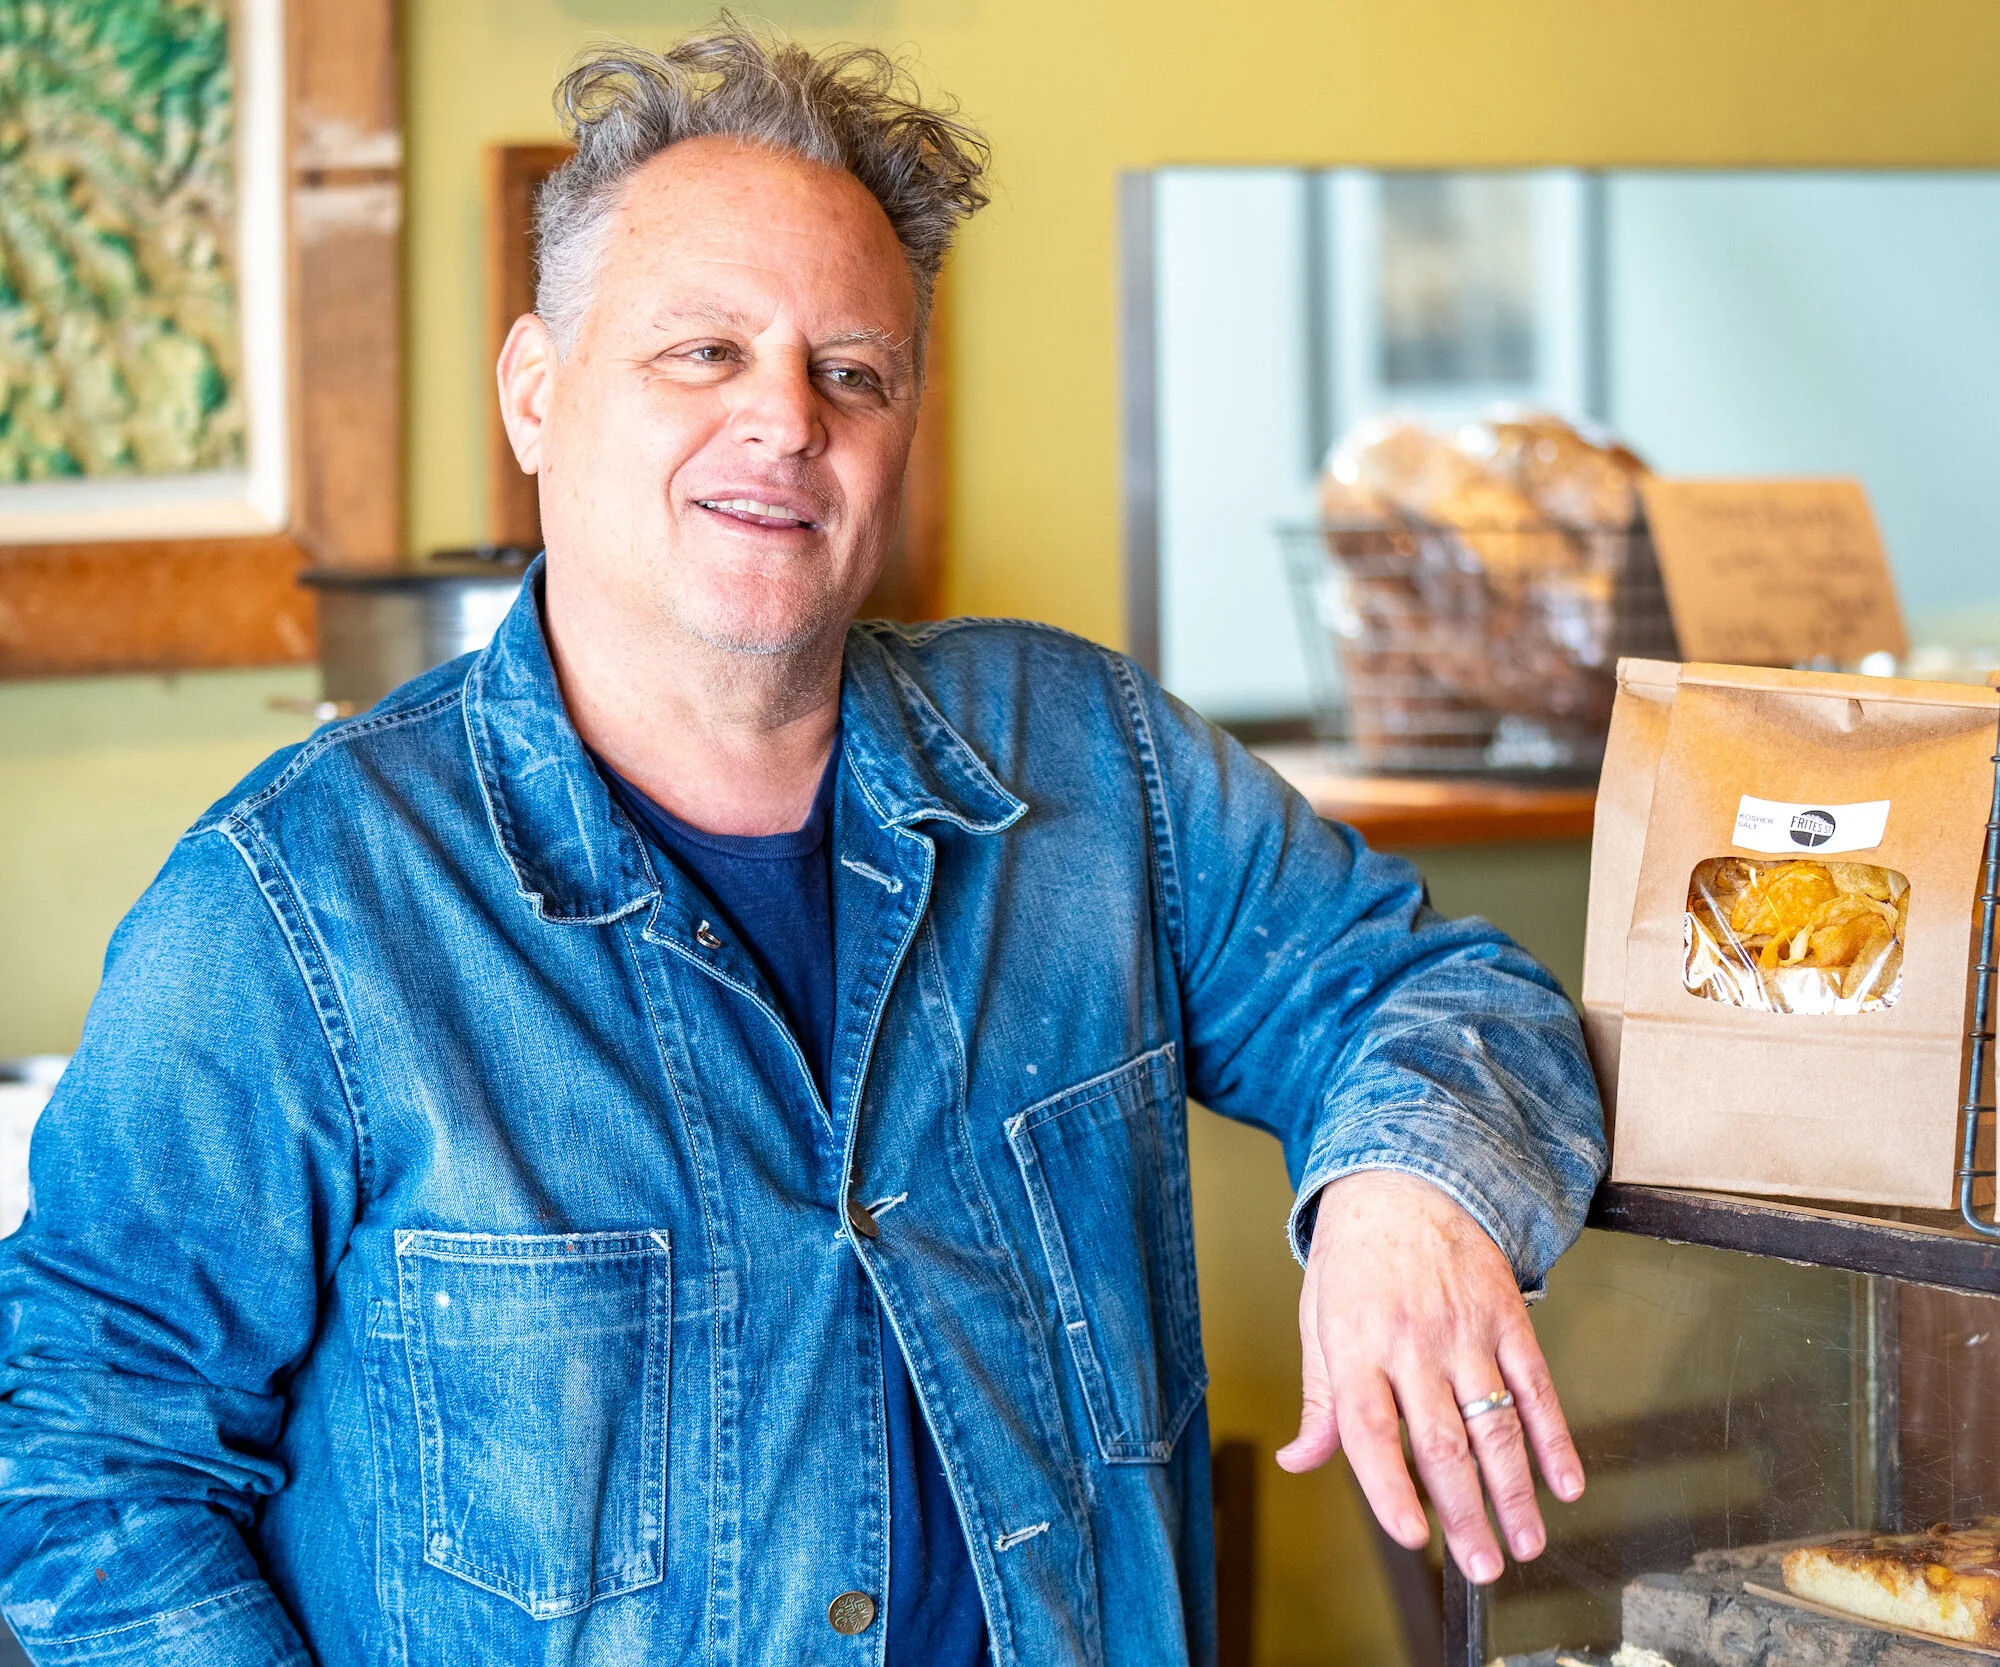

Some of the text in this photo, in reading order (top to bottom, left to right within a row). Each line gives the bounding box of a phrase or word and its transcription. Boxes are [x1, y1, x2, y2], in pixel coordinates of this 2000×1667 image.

[1737, 821, 1757, 830] SALT
[1739, 813, 1774, 824] KOSHER
[1790, 815, 1823, 833] FRITES
[854, 1598, 869, 1619] LEVI
